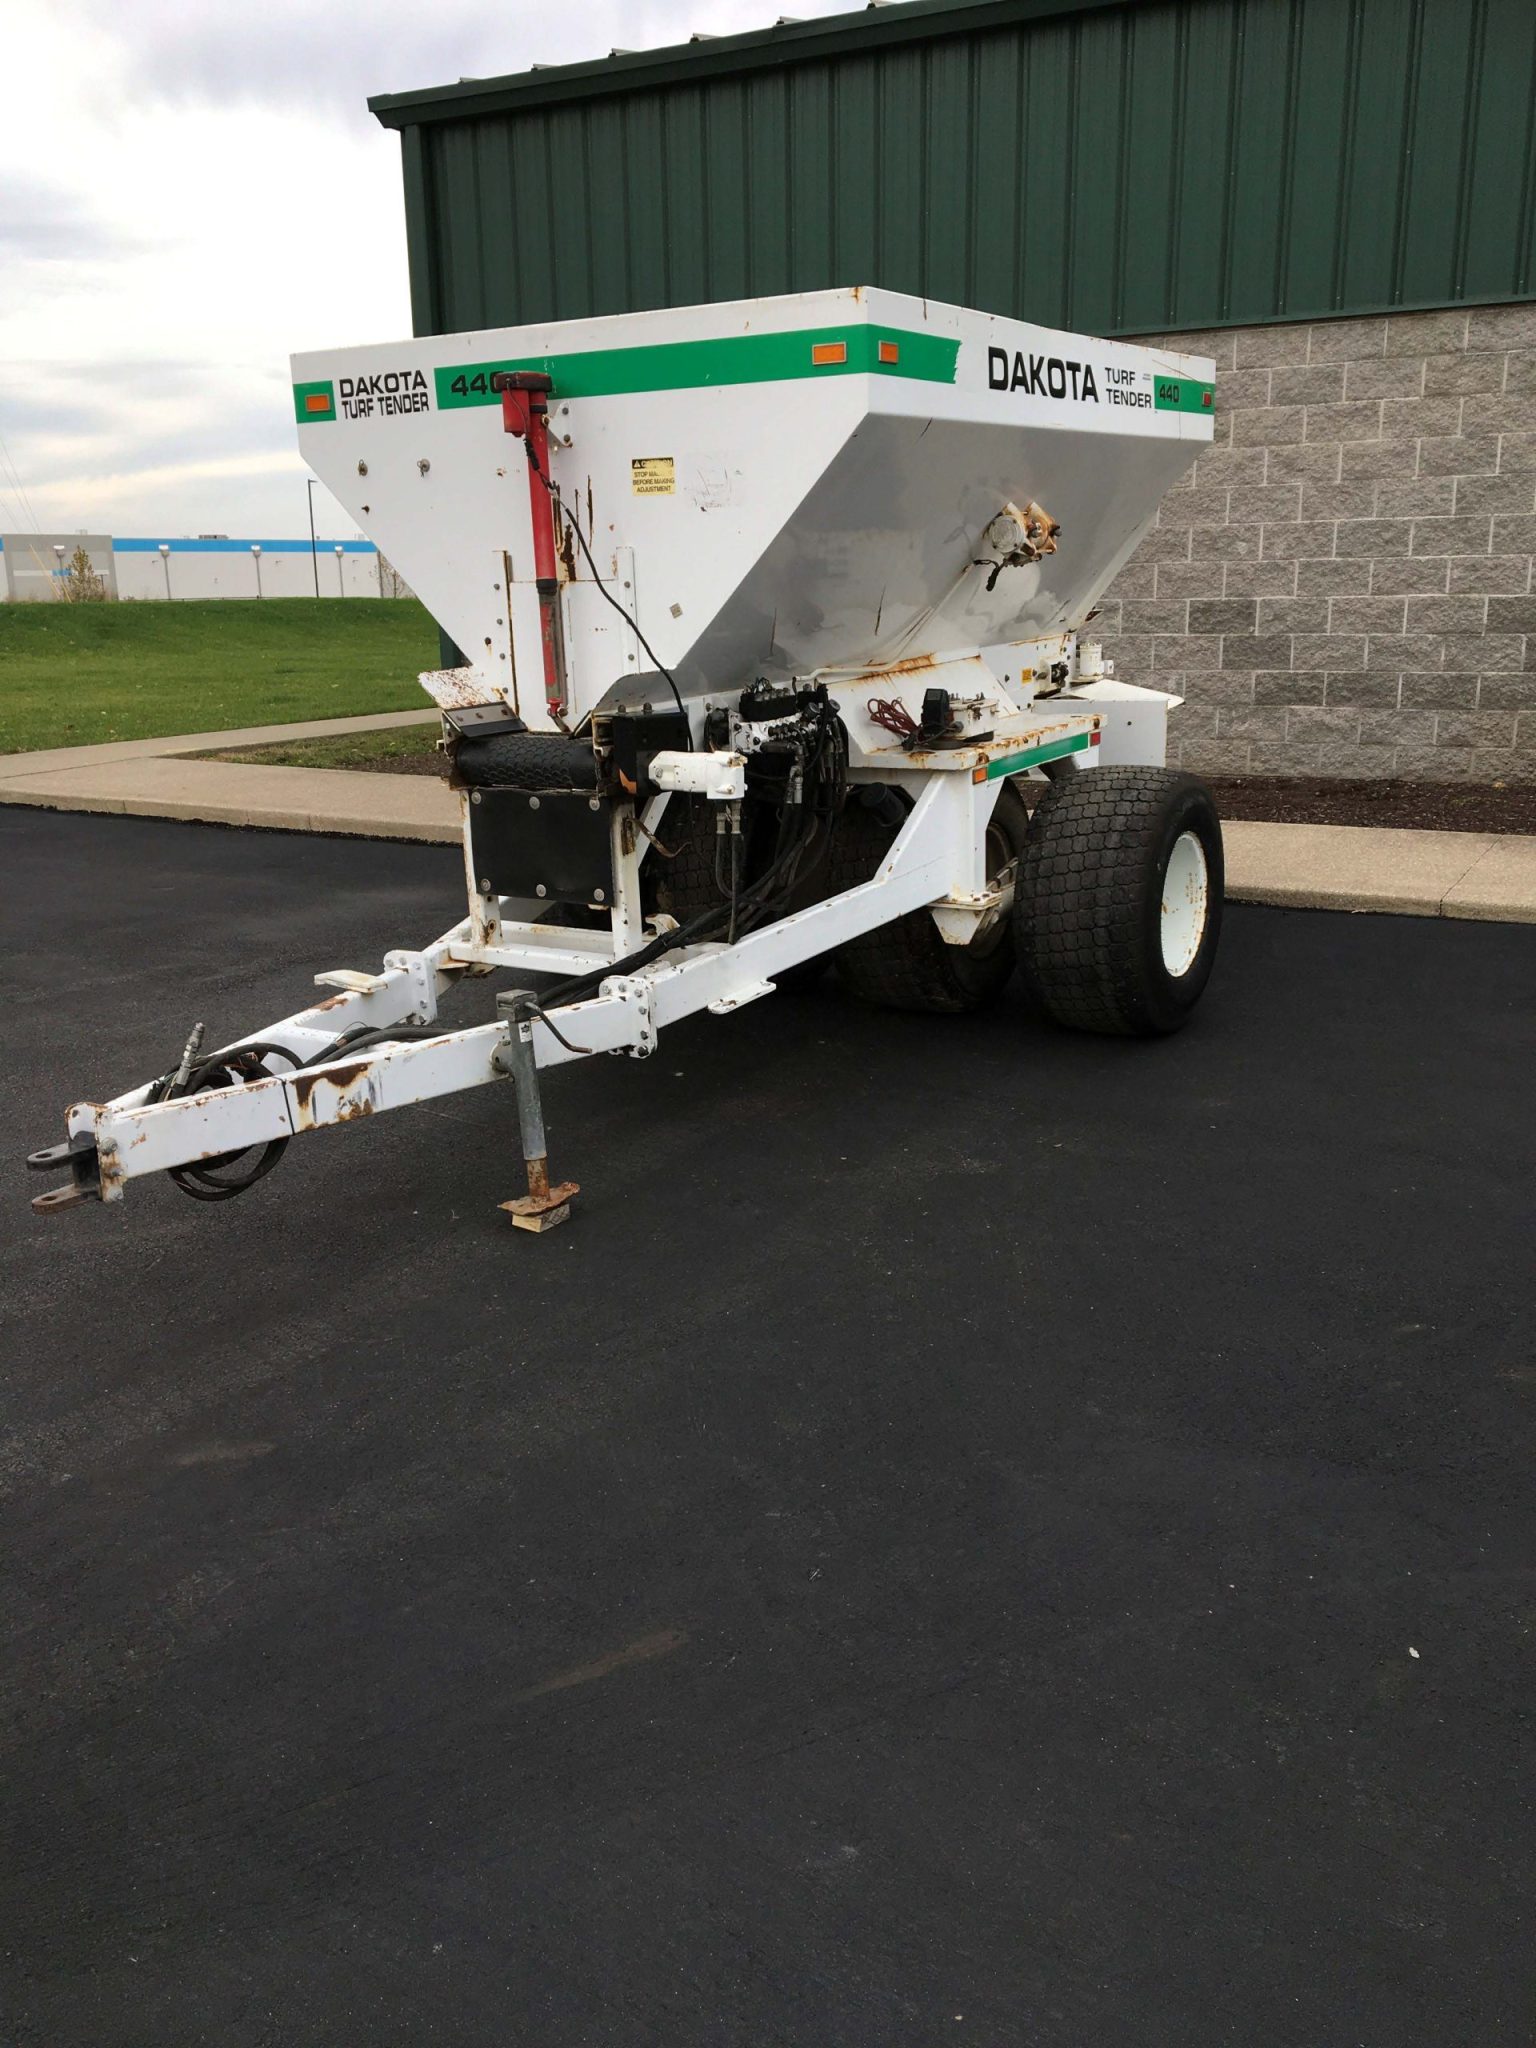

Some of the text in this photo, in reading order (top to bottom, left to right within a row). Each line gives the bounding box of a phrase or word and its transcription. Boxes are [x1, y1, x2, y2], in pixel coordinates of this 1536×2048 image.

[339, 370, 428, 398] DAKOTA
[987, 346, 1099, 403] DAKOTA
[1104, 367, 1136, 386] TURF
[1105, 388, 1152, 409] TENDER
[1159, 383, 1180, 403] 440
[341, 392, 430, 420] TURF TENDER
